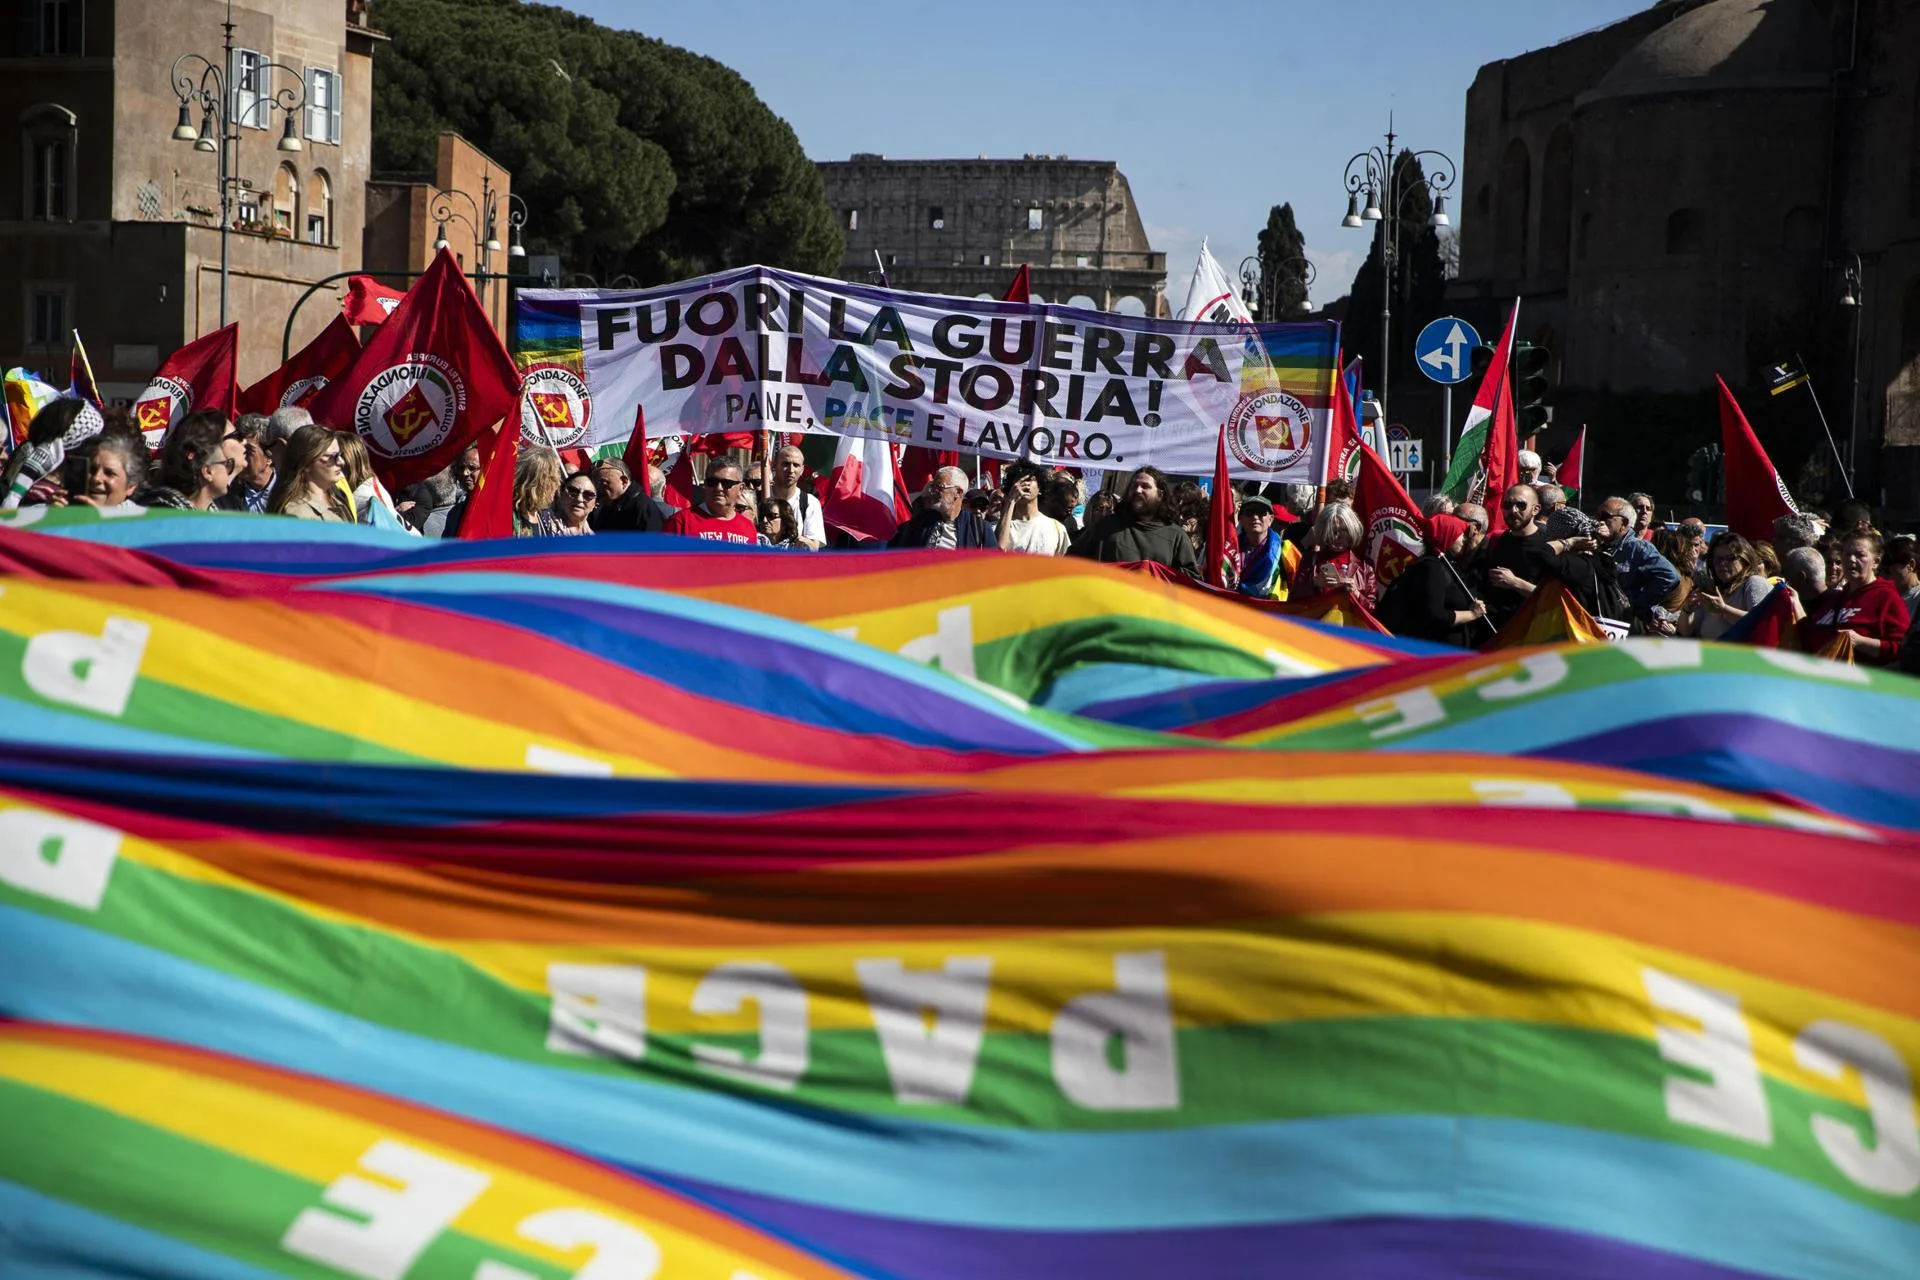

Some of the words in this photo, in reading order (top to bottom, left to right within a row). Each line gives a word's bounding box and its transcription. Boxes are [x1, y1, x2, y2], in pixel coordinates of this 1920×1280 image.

[596, 283, 803, 351] FUORI
[828, 297, 916, 352] LA
[931, 314, 1233, 383] GUERRA
[527, 370, 589, 400] ONDAZIONE
[660, 334, 870, 392] DALLA
[883, 354, 1163, 428] STORIA!
[1243, 394, 1309, 424] RIFONDAZIONE
[520, 424, 545, 445] PARTITO
[726, 393, 815, 430] PANE,
[824, 398, 915, 436] PACE
[926, 414, 945, 443] E
[957, 418, 1124, 463] LAVORO.
[1243, 445, 1265, 465] PARTITO
[1266, 448, 1304, 467] COMUNISTA
[1337, 447, 1350, 479] NISTRA
[699, 531, 723, 541] NEW
[727, 531, 750, 545] YORK
